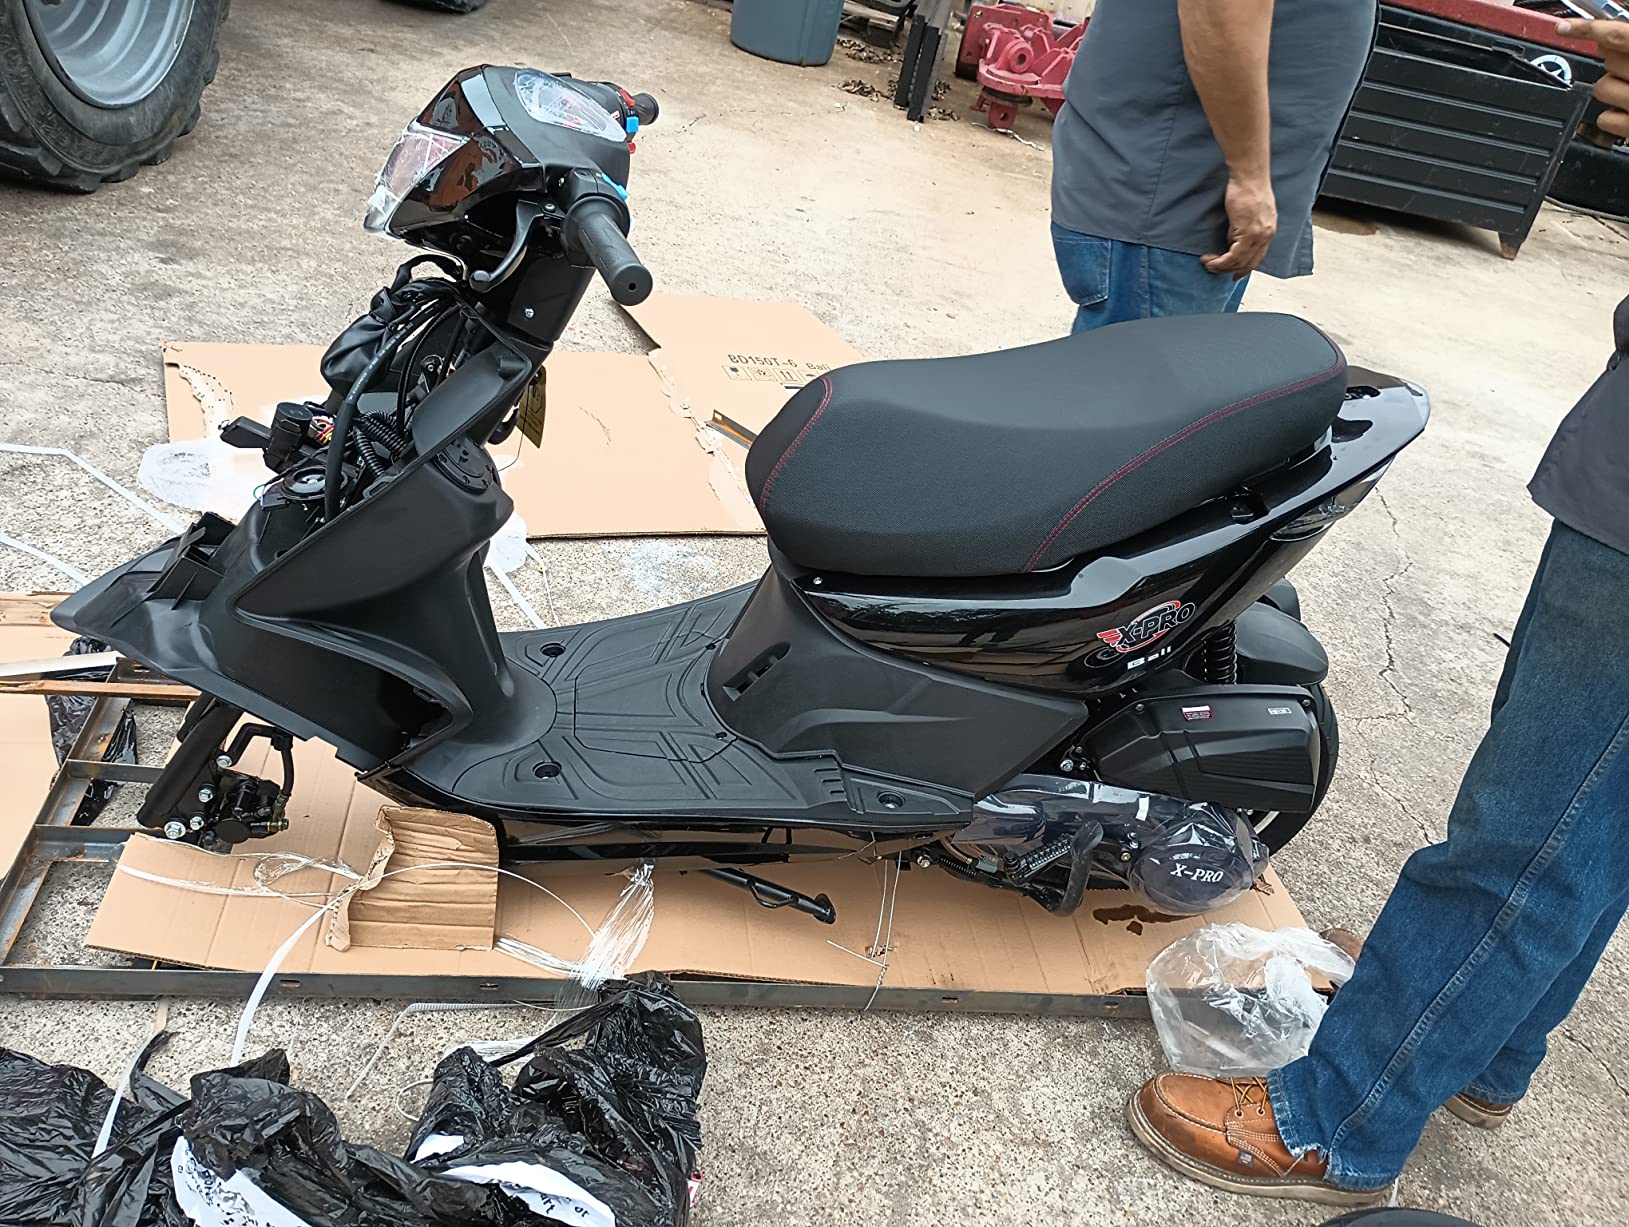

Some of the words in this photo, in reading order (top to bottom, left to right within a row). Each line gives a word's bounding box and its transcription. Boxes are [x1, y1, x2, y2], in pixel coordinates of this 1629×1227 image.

[728, 354, 798, 368] BD150T-6
[1118, 602, 1196, 648] X-PRO
[1170, 863, 1224, 882] X-PRO
